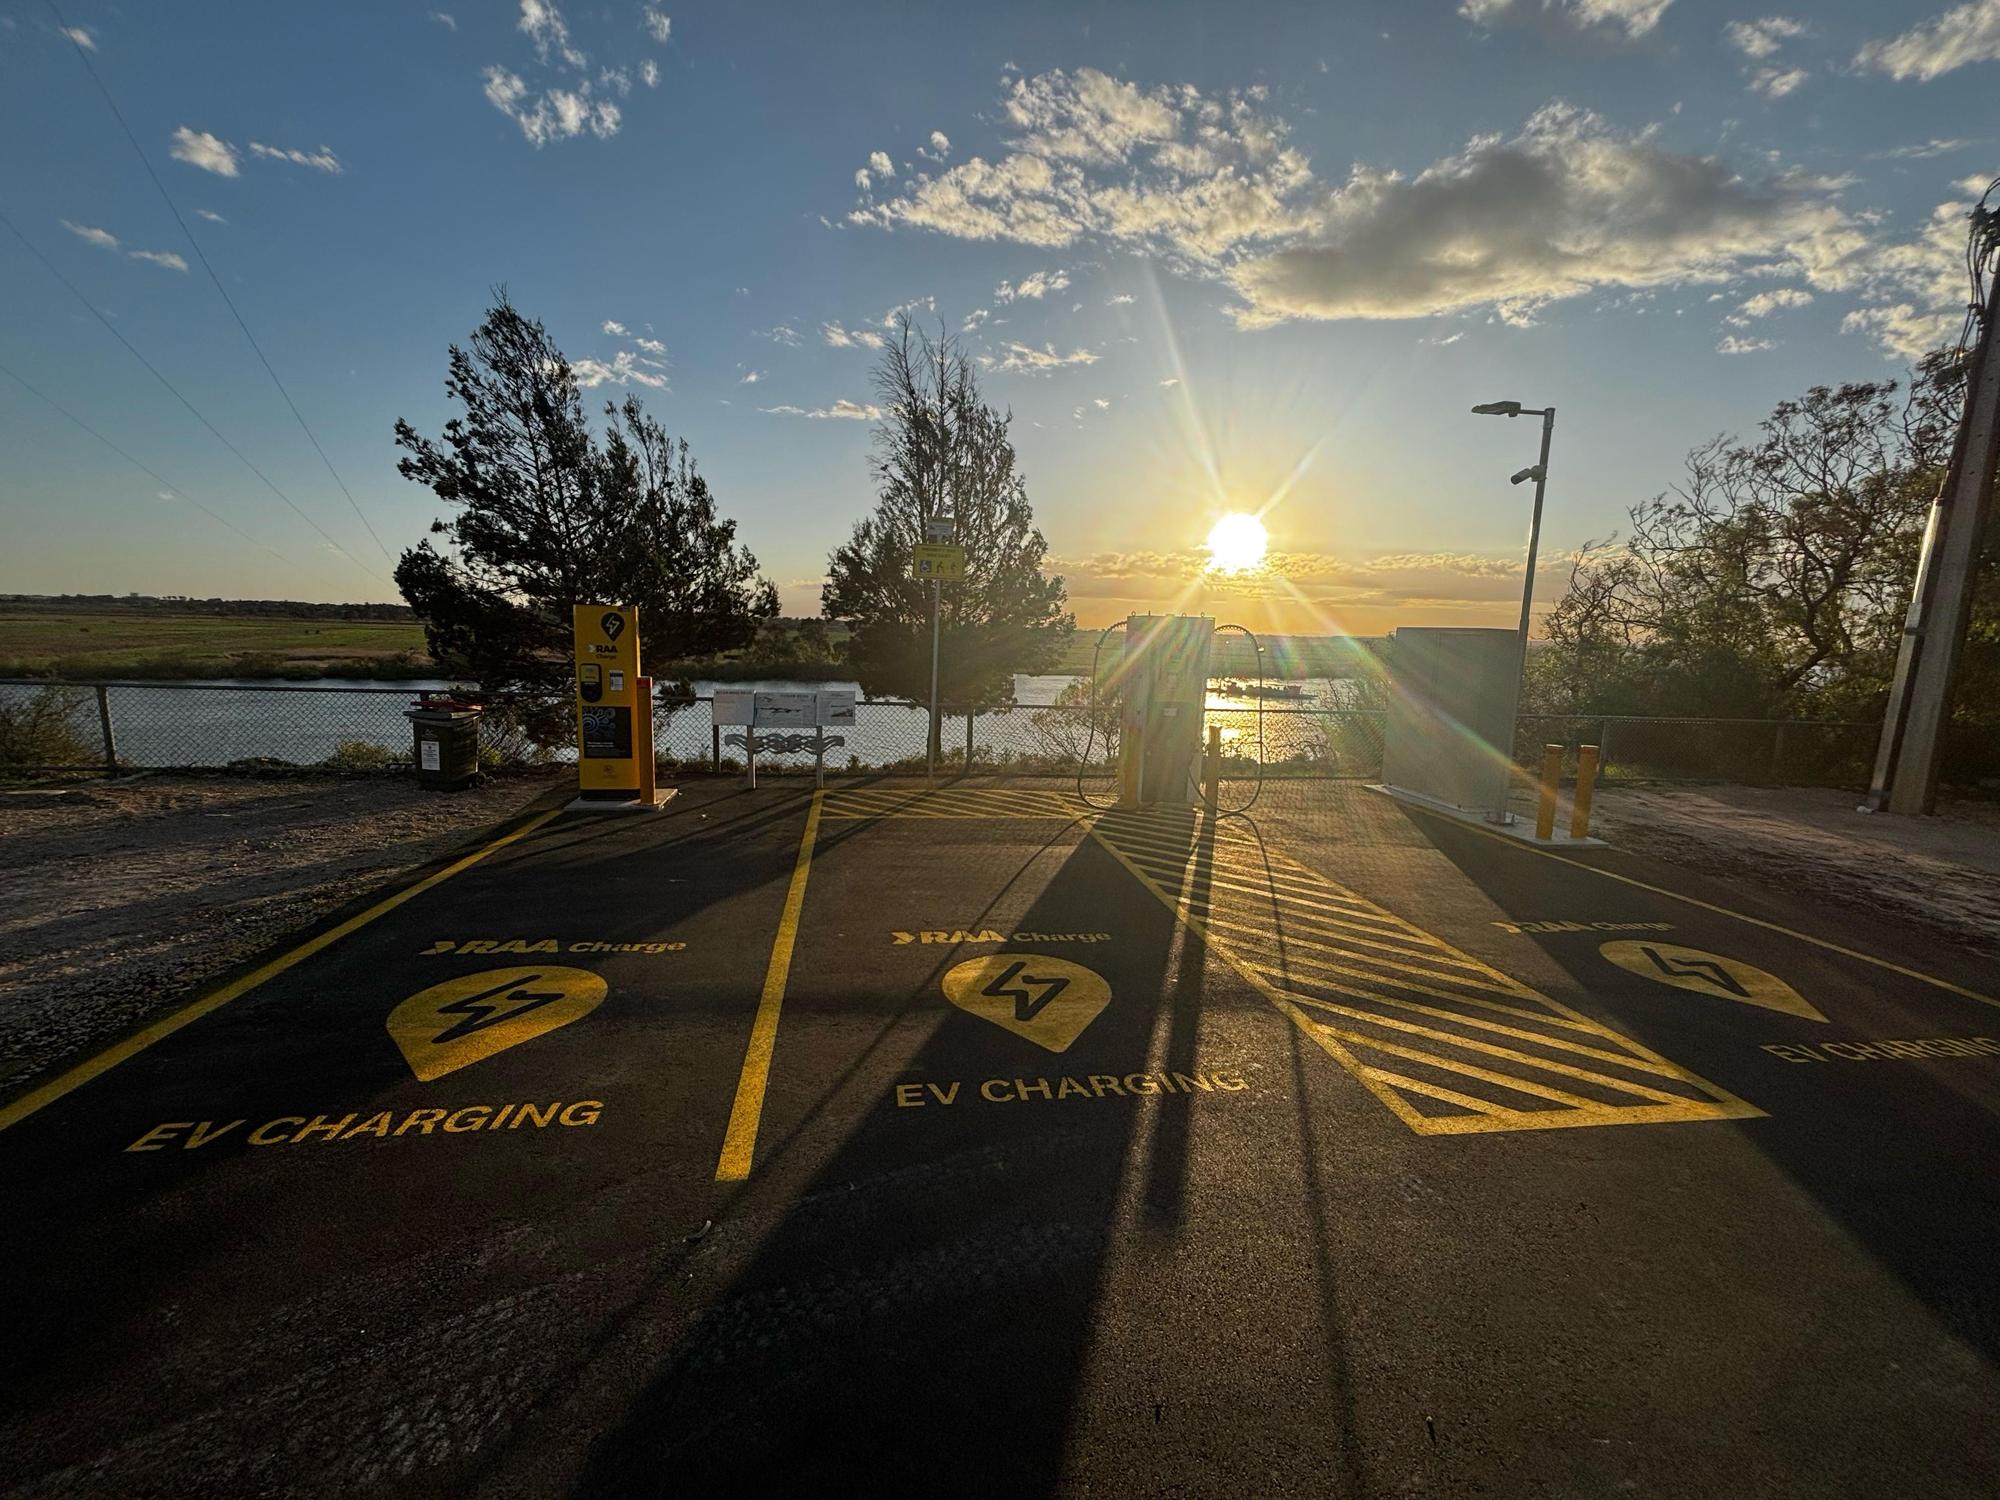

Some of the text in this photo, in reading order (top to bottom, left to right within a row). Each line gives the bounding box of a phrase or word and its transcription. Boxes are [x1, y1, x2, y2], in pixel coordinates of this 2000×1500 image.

[596, 644, 618, 653] RAA
[919, 929, 1112, 944] RAA Charge
[454, 939, 687, 954] RAA Charge
[1759, 1043, 1830, 1063] EV
[895, 1070, 1250, 1107] EV CHARGING
[121, 1100, 605, 1152] EV CHARGING
